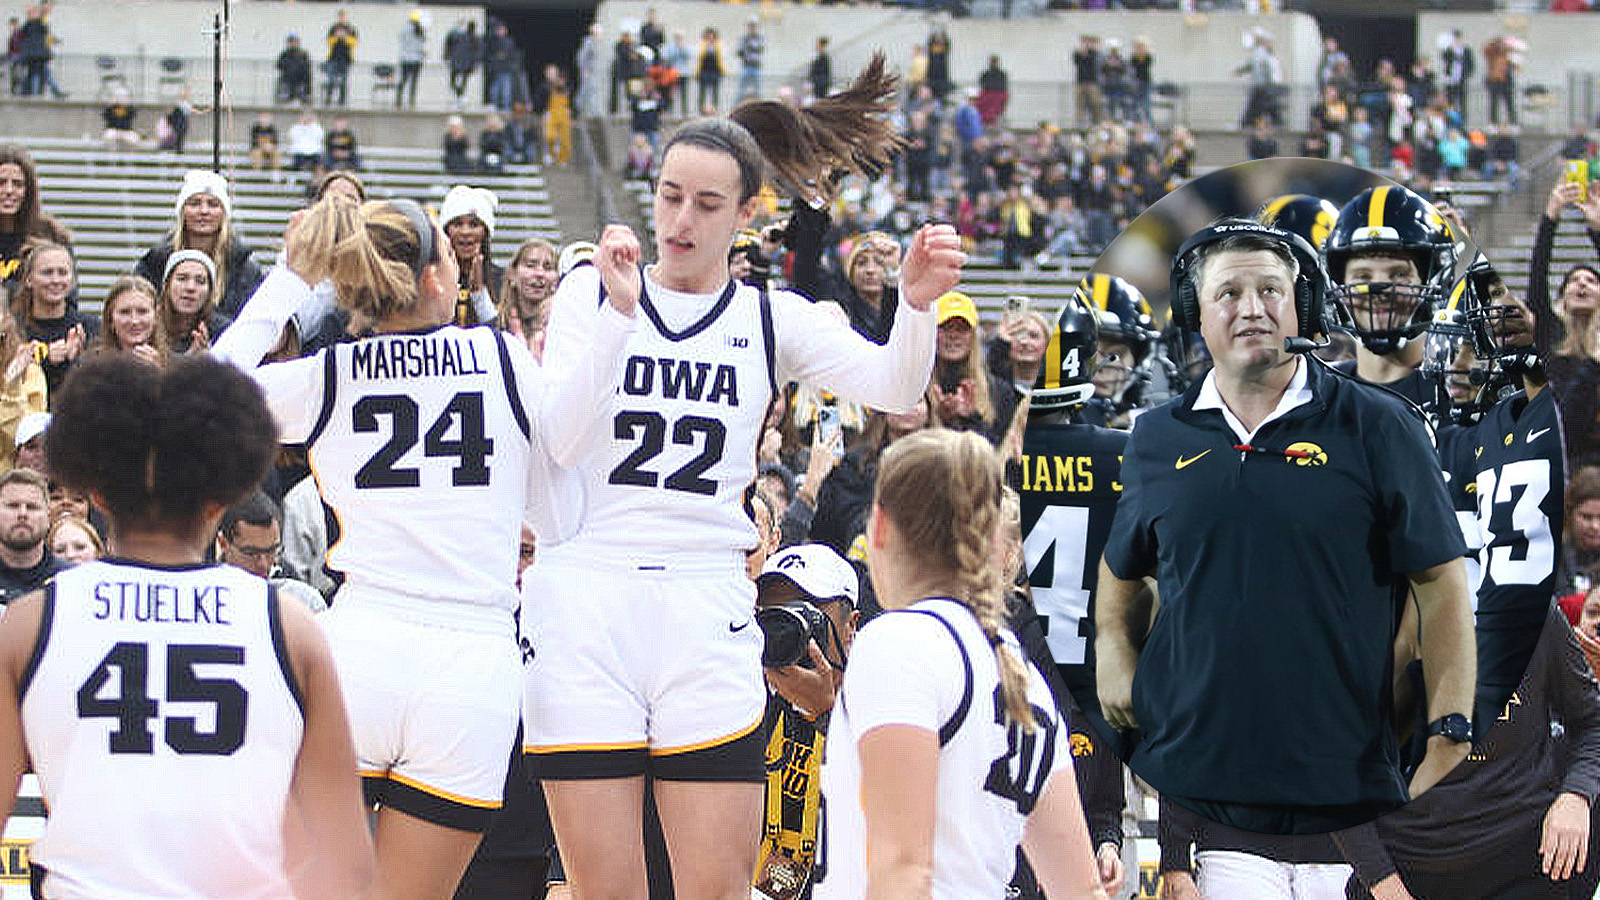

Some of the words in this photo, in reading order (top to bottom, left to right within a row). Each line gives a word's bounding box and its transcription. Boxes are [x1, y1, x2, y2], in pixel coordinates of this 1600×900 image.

[352, 337, 488, 380] MARSHALL
[616, 355, 739, 407] OWA
[1061, 347, 1081, 378] 4
[352, 391, 494, 489] 24
[608, 409, 728, 496] 22
[1021, 454, 1094, 492] IAMS
[93, 581, 231, 625] STUELKE
[1022, 504, 1091, 665] 4
[77, 641, 249, 756] 45
